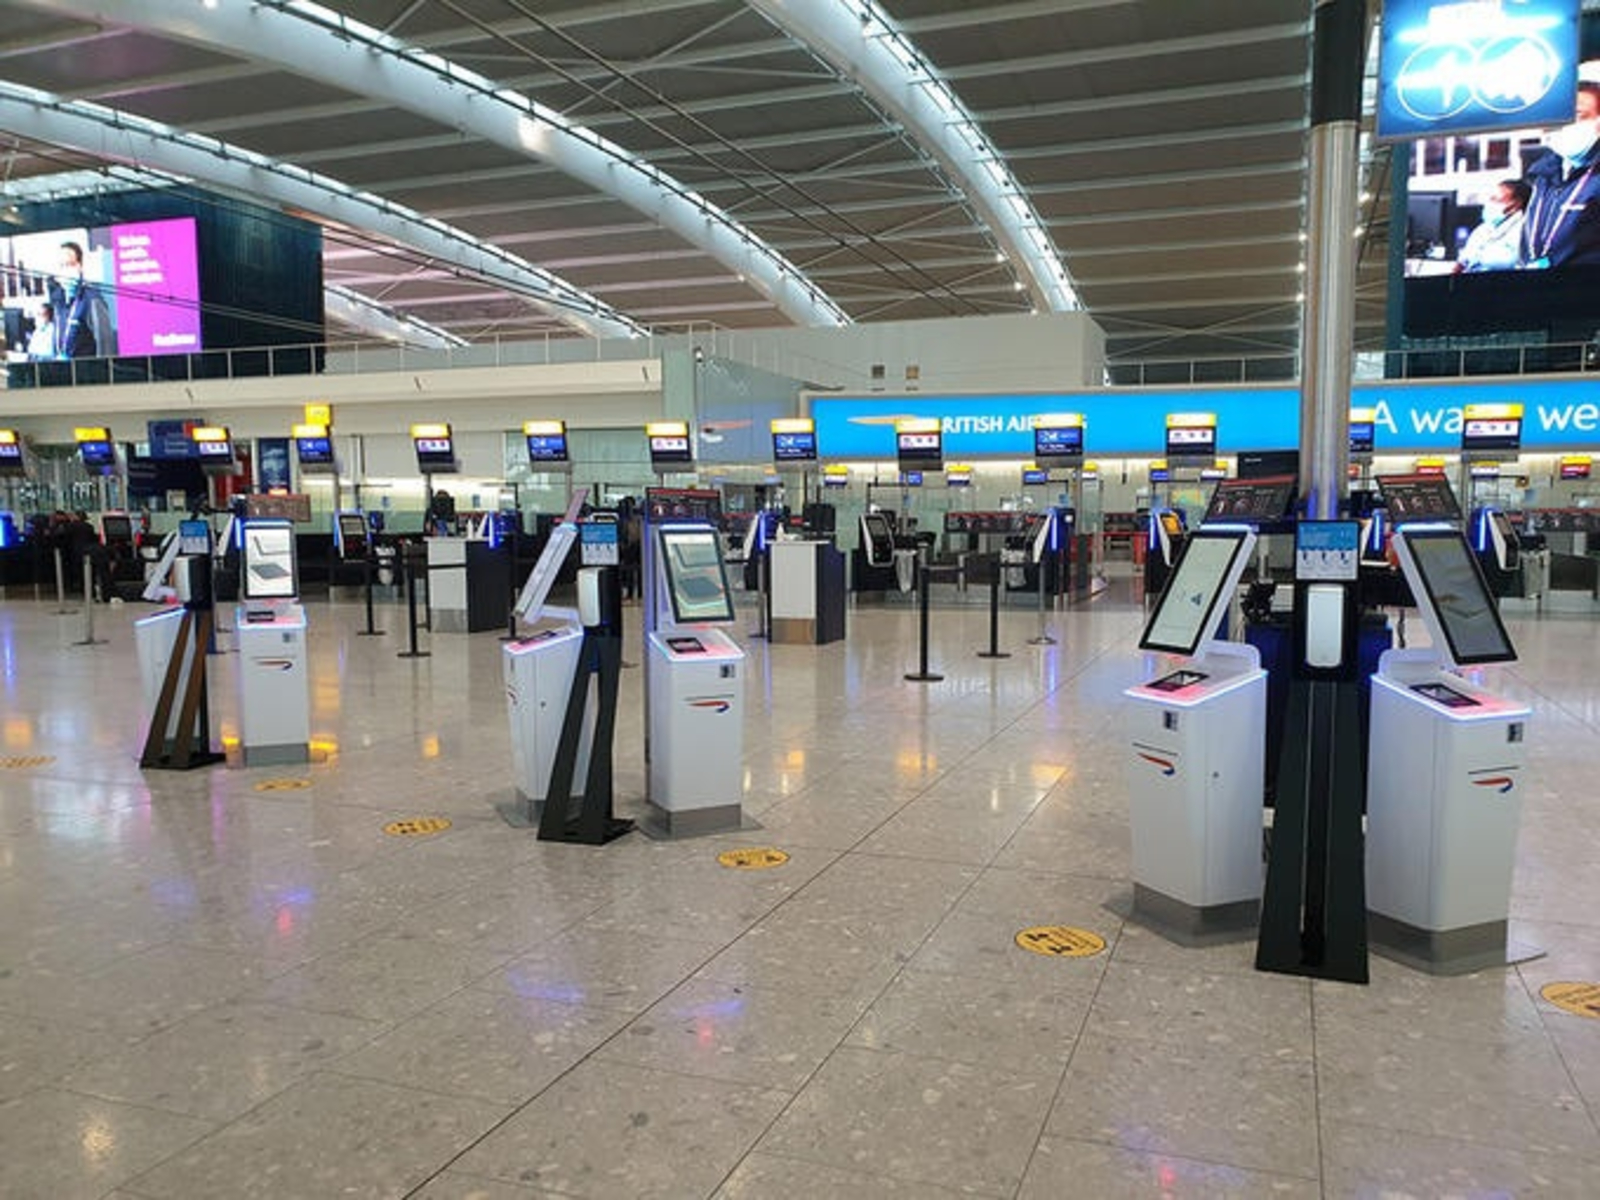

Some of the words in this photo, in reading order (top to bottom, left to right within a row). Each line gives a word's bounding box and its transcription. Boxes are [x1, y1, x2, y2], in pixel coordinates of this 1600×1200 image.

[941, 416, 1003, 434] RITISH
[1374, 399, 1398, 434] A
[1410, 407, 1464, 434] wa
[1537, 404, 1599, 432] we
